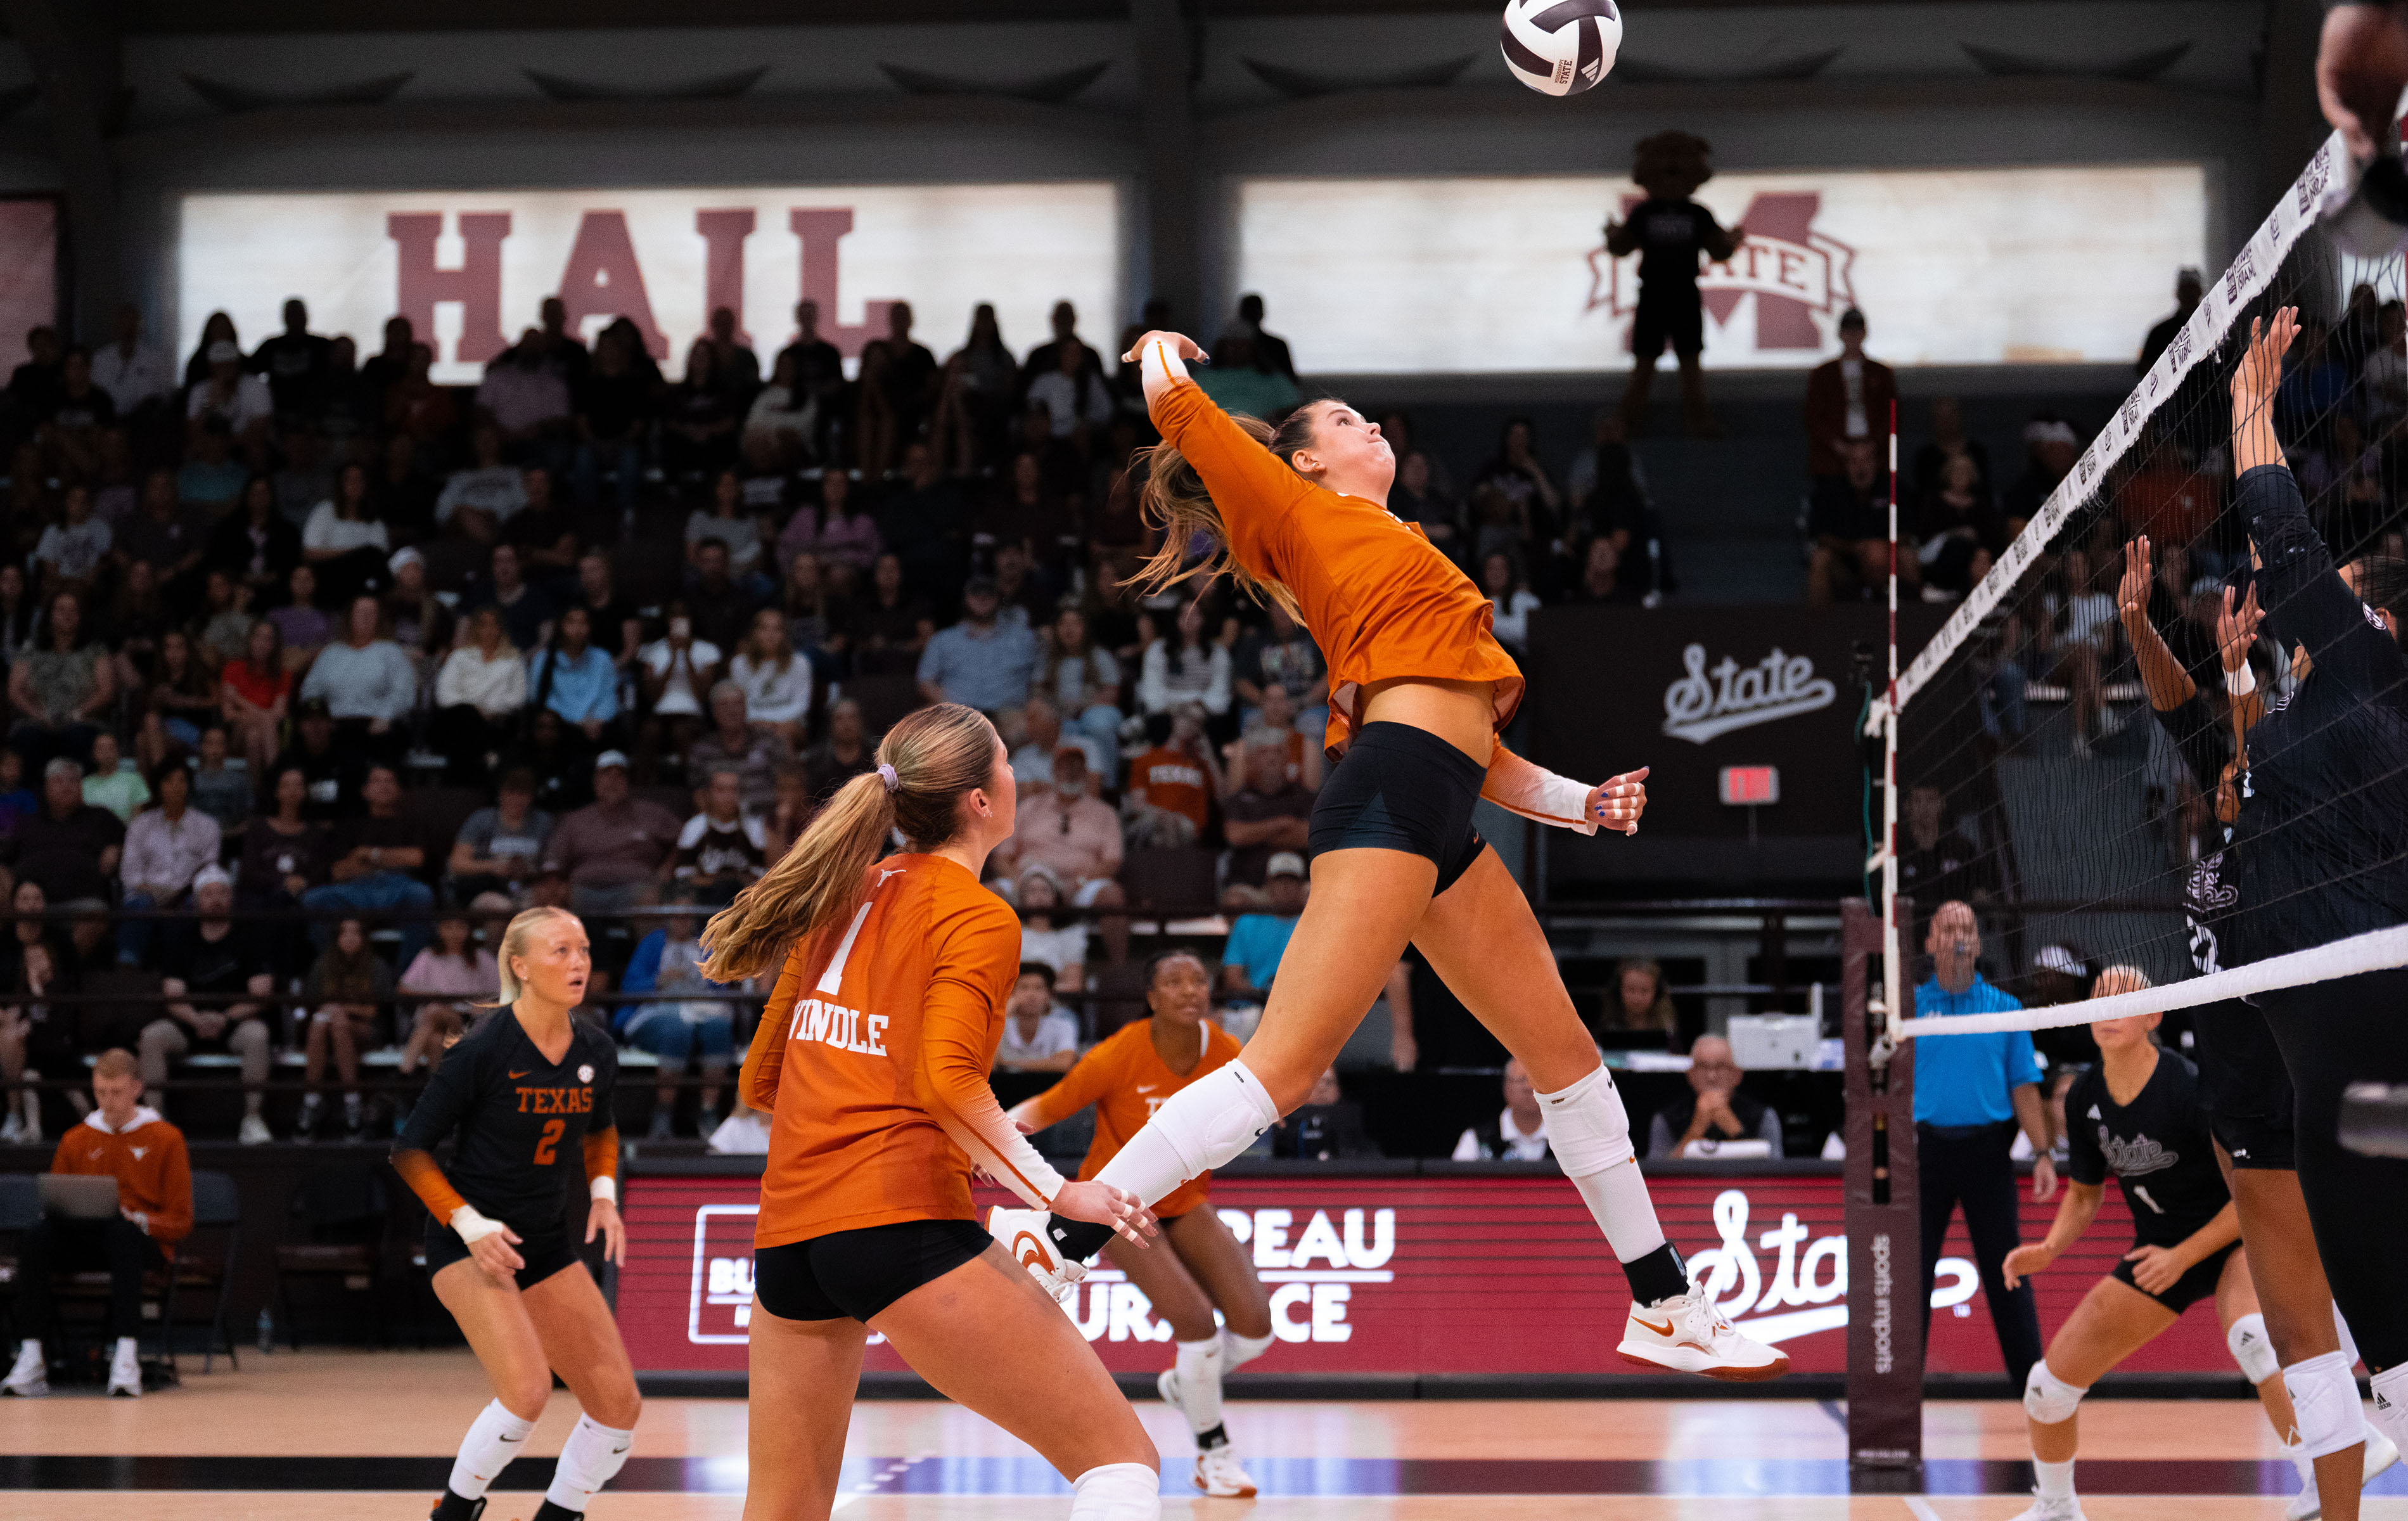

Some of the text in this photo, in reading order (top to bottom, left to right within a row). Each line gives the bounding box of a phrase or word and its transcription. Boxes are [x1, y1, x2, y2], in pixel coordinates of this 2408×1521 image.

[1559, 60, 1573, 84] STATE
[386, 208, 900, 363] HAIL
[1662, 643, 1836, 744] State
[816, 901, 873, 996] 1
[515, 1086, 593, 1114] TEXAS
[533, 1119, 566, 1165] 2
[1870, 1235, 1894, 1374] sports imports
